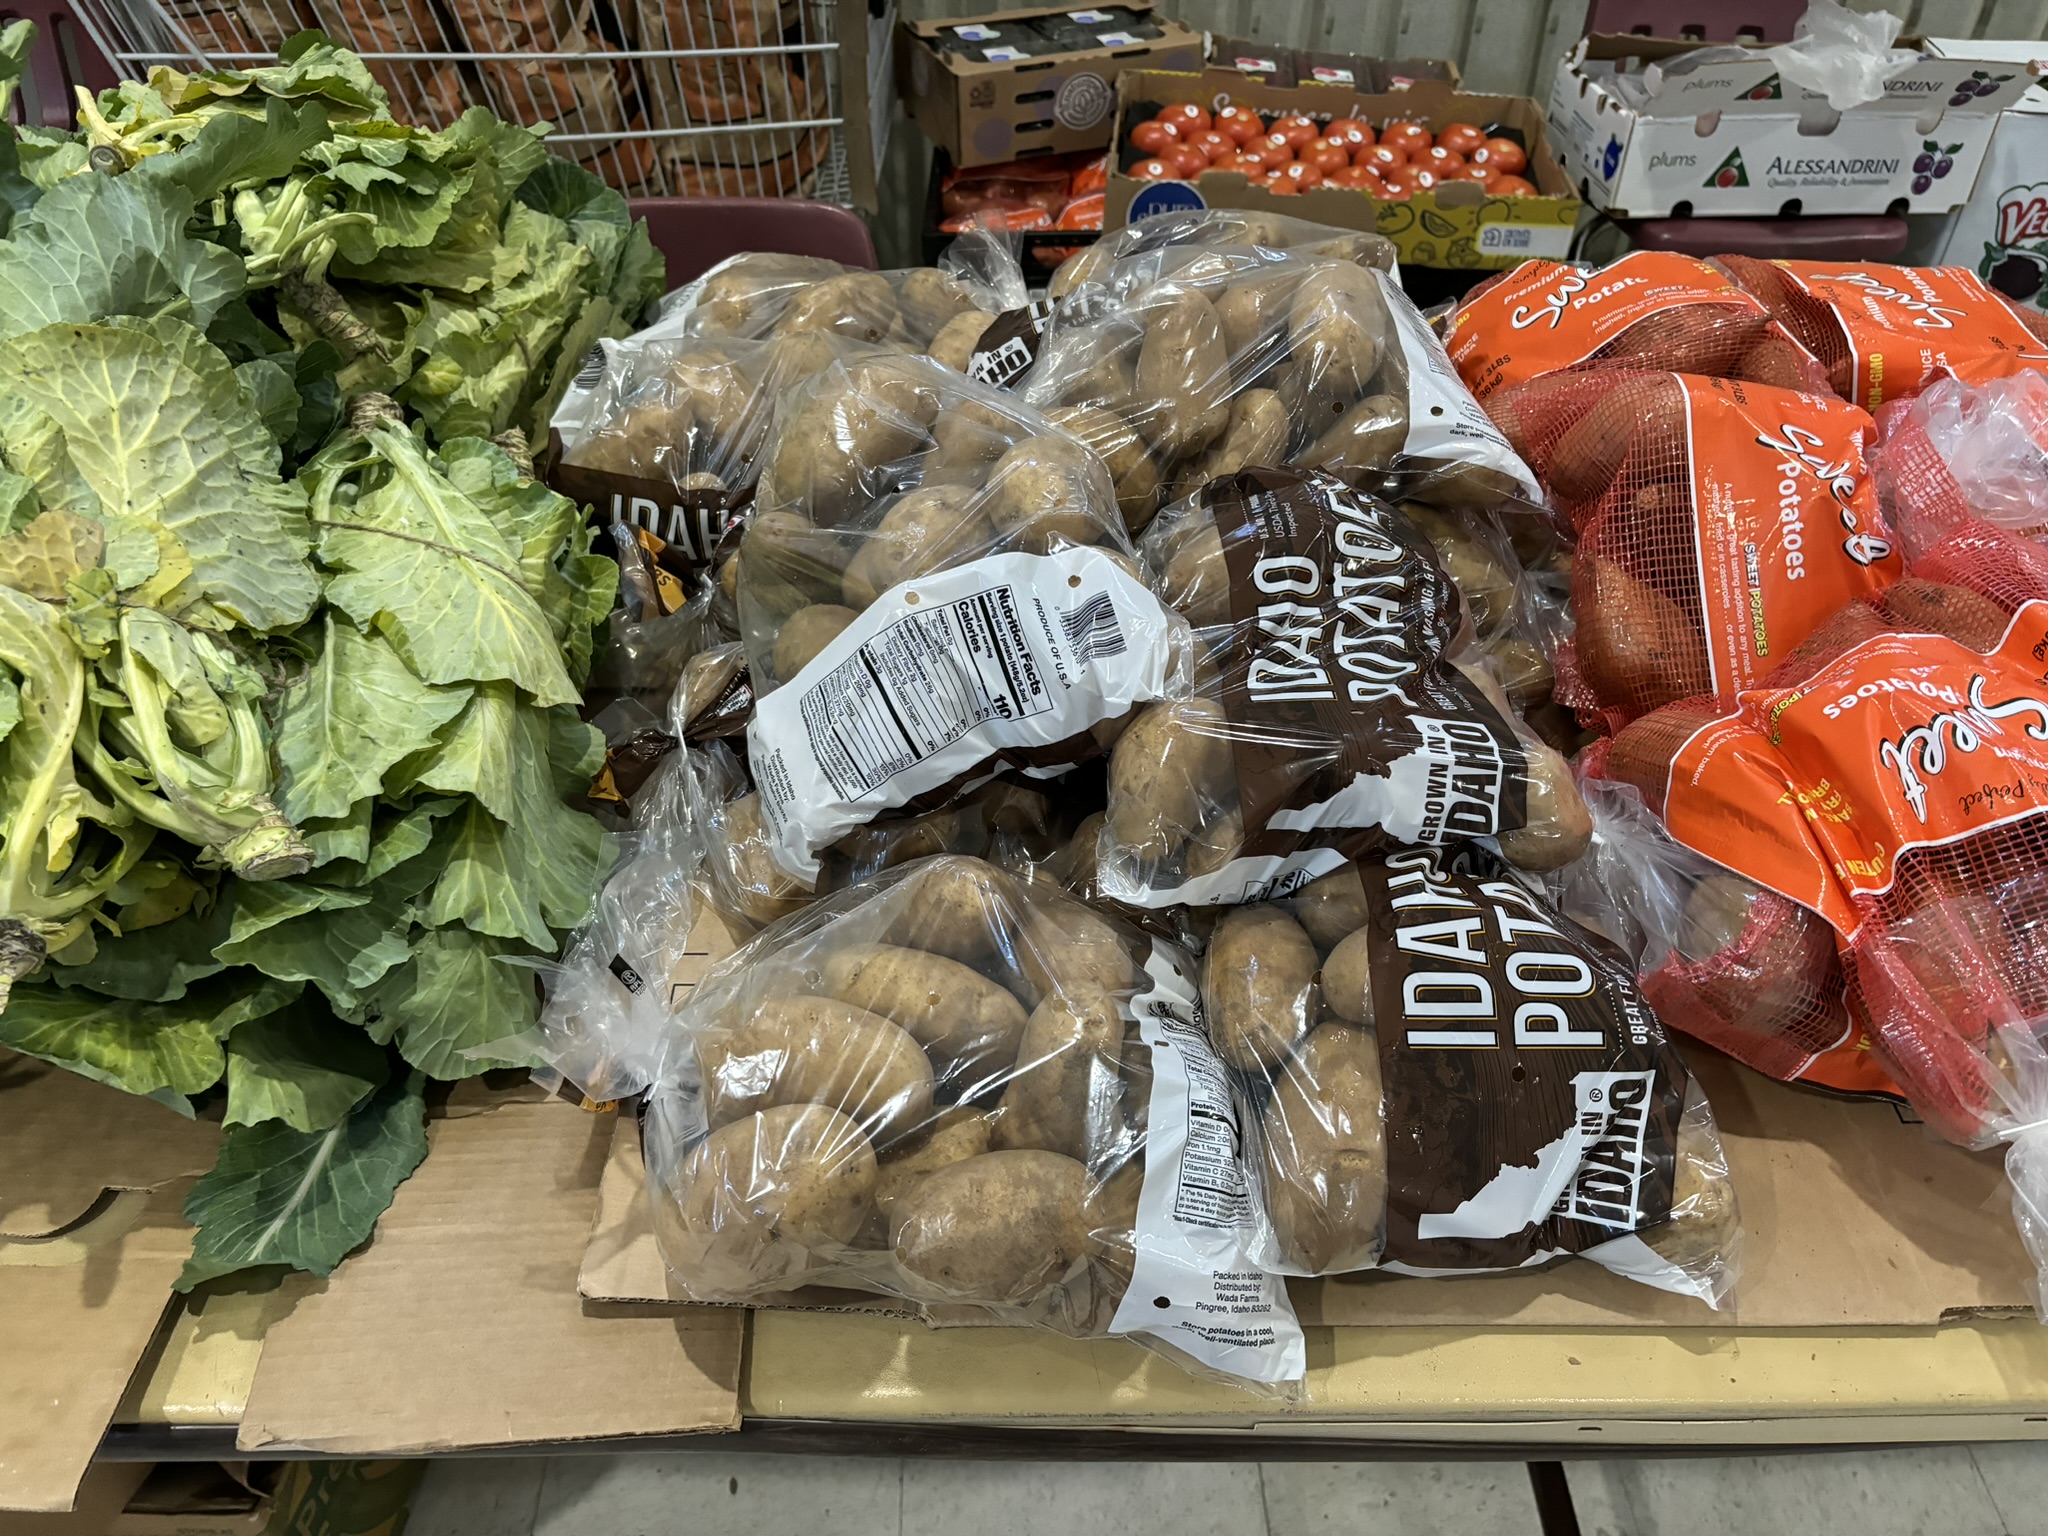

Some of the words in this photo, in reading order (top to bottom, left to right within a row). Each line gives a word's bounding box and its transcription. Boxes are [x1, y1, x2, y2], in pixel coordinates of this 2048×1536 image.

[1683, 77, 1734, 92] plums
[1649, 152, 1697, 171] plums
[1766, 156, 1900, 175] ALESSANDRINI
[1503, 264, 1569, 305] Premium
[987, 350, 1002, 364] IN
[1456, 422, 1474, 430] Store
[1756, 424, 1892, 567] Sweet
[610, 493, 729, 561] IDAH
[1270, 513, 1284, 537] USDA
[1280, 502, 1298, 536] Inspected
[1713, 521, 1725, 541] fried
[1716, 542, 1724, 552] or
[1725, 533, 1738, 555] great
[1717, 553, 1727, 562] in
[1741, 542, 1762, 587] SWEET
[1423, 573, 1434, 581] &
[1727, 557, 1742, 586] tasting
[1732, 587, 1747, 622] addition
[969, 598, 982, 623] Amount
[976, 623, 985, 634] per
[982, 635, 993, 658] serving
[986, 592, 998, 619] Serving
[995, 619, 1003, 633] size
[1000, 637, 1013, 660] potato
[1033, 598, 1055, 644] PRODUCE
[1050, 646, 1061, 660] OF
[1725, 624, 1733, 633] or
[1737, 623, 1747, 634] to
[1746, 590, 1770, 657] POTATOES
[903, 619, 917, 642] Sodium
[914, 642, 924, 657] 0mg
[911, 616, 932, 650] Cholesterol
[929, 649, 939, 664] 0mg
[997, 588, 1025, 652] Nutrition
[1020, 652, 1041, 695] Facts
[1726, 635, 1736, 655] even
[1737, 635, 1748, 651] any
[884, 641, 894, 657] Total
[890, 656, 904, 679] Sugars
[901, 677, 908, 686] 1g
[895, 624, 906, 641] Total
[903, 640, 927, 681] Carbohydrate
[959, 601, 981, 653] Calories
[993, 694, 1012, 719] 110
[1729, 657, 1738, 668] as
[1741, 652, 1752, 675] meal.
[874, 664, 883, 675] 3g
[937, 608, 947, 625] Total
[947, 636, 953, 646] 0g
[974, 710, 982, 721] 0%
[891, 636, 904, 657] Dietary
[901, 657, 912, 672] Fiber
[910, 672, 917, 683] 2g
[944, 731, 952, 742] 7%
[842, 694, 856, 718] 620mg
[879, 652, 894, 678] Includes
[896, 685, 910, 706] Added
[906, 704, 920, 728] Sugars
[927, 740, 936, 751] 0%
[983, 707, 990, 718] 0%
[854, 680, 866, 699] 20mg
[896, 757, 905, 769] 2%
[864, 679, 872, 689] 0g
[904, 752, 913, 765] 0%
[1424, 733, 1449, 756] IN
[1706, 737, 1726, 756] them
[1879, 673, 2048, 825] Sweet
[770, 755, 786, 792] Distributed
[775, 748, 787, 774] Packed
[783, 772, 789, 781] in
[786, 780, 796, 800] Idaho
[1417, 763, 1449, 841] GROWN
[1958, 778, 2026, 816] Perfect
[629, 979, 643, 992] RPL
[1631, 995, 1648, 1044] GREAT
[1647, 1006, 1666, 1044] Vitamin
[1190, 1101, 1216, 1111] Protein
[1216, 1106, 1225, 1115] 3g
[1190, 1120, 1215, 1130] Vitamin
[1581, 1111, 1604, 1136] IN
[1190, 1130, 1215, 1141] Calcium
[1185, 1151, 1221, 1164] Potassium
[1200, 1144, 1221, 1154] 1.1mg
[1182, 1174, 1210, 1184] Vitamin
[1184, 1162, 1210, 1173] Vitamin
[1190, 1198, 1210, 1207] serving
[1204, 1193, 1218, 1201] Daily
[1213, 1271, 1240, 1280] Packed
[1241, 1272, 1247, 1280] in
[1247, 1272, 1263, 1280] Idaho
[1214, 1282, 1252, 1291] Distributed
[1195, 1302, 1229, 1314] Pingree,
[1231, 1305, 1250, 1313] Idaho
[1216, 1293, 1238, 1302] Wada
[1240, 1294, 1260, 1302] Farms
[1181, 1321, 1206, 1331] Store
[1207, 1328, 1245, 1337] potatoes
[1246, 1328, 1252, 1337] in
[1258, 1327, 1274, 1336] cool,
